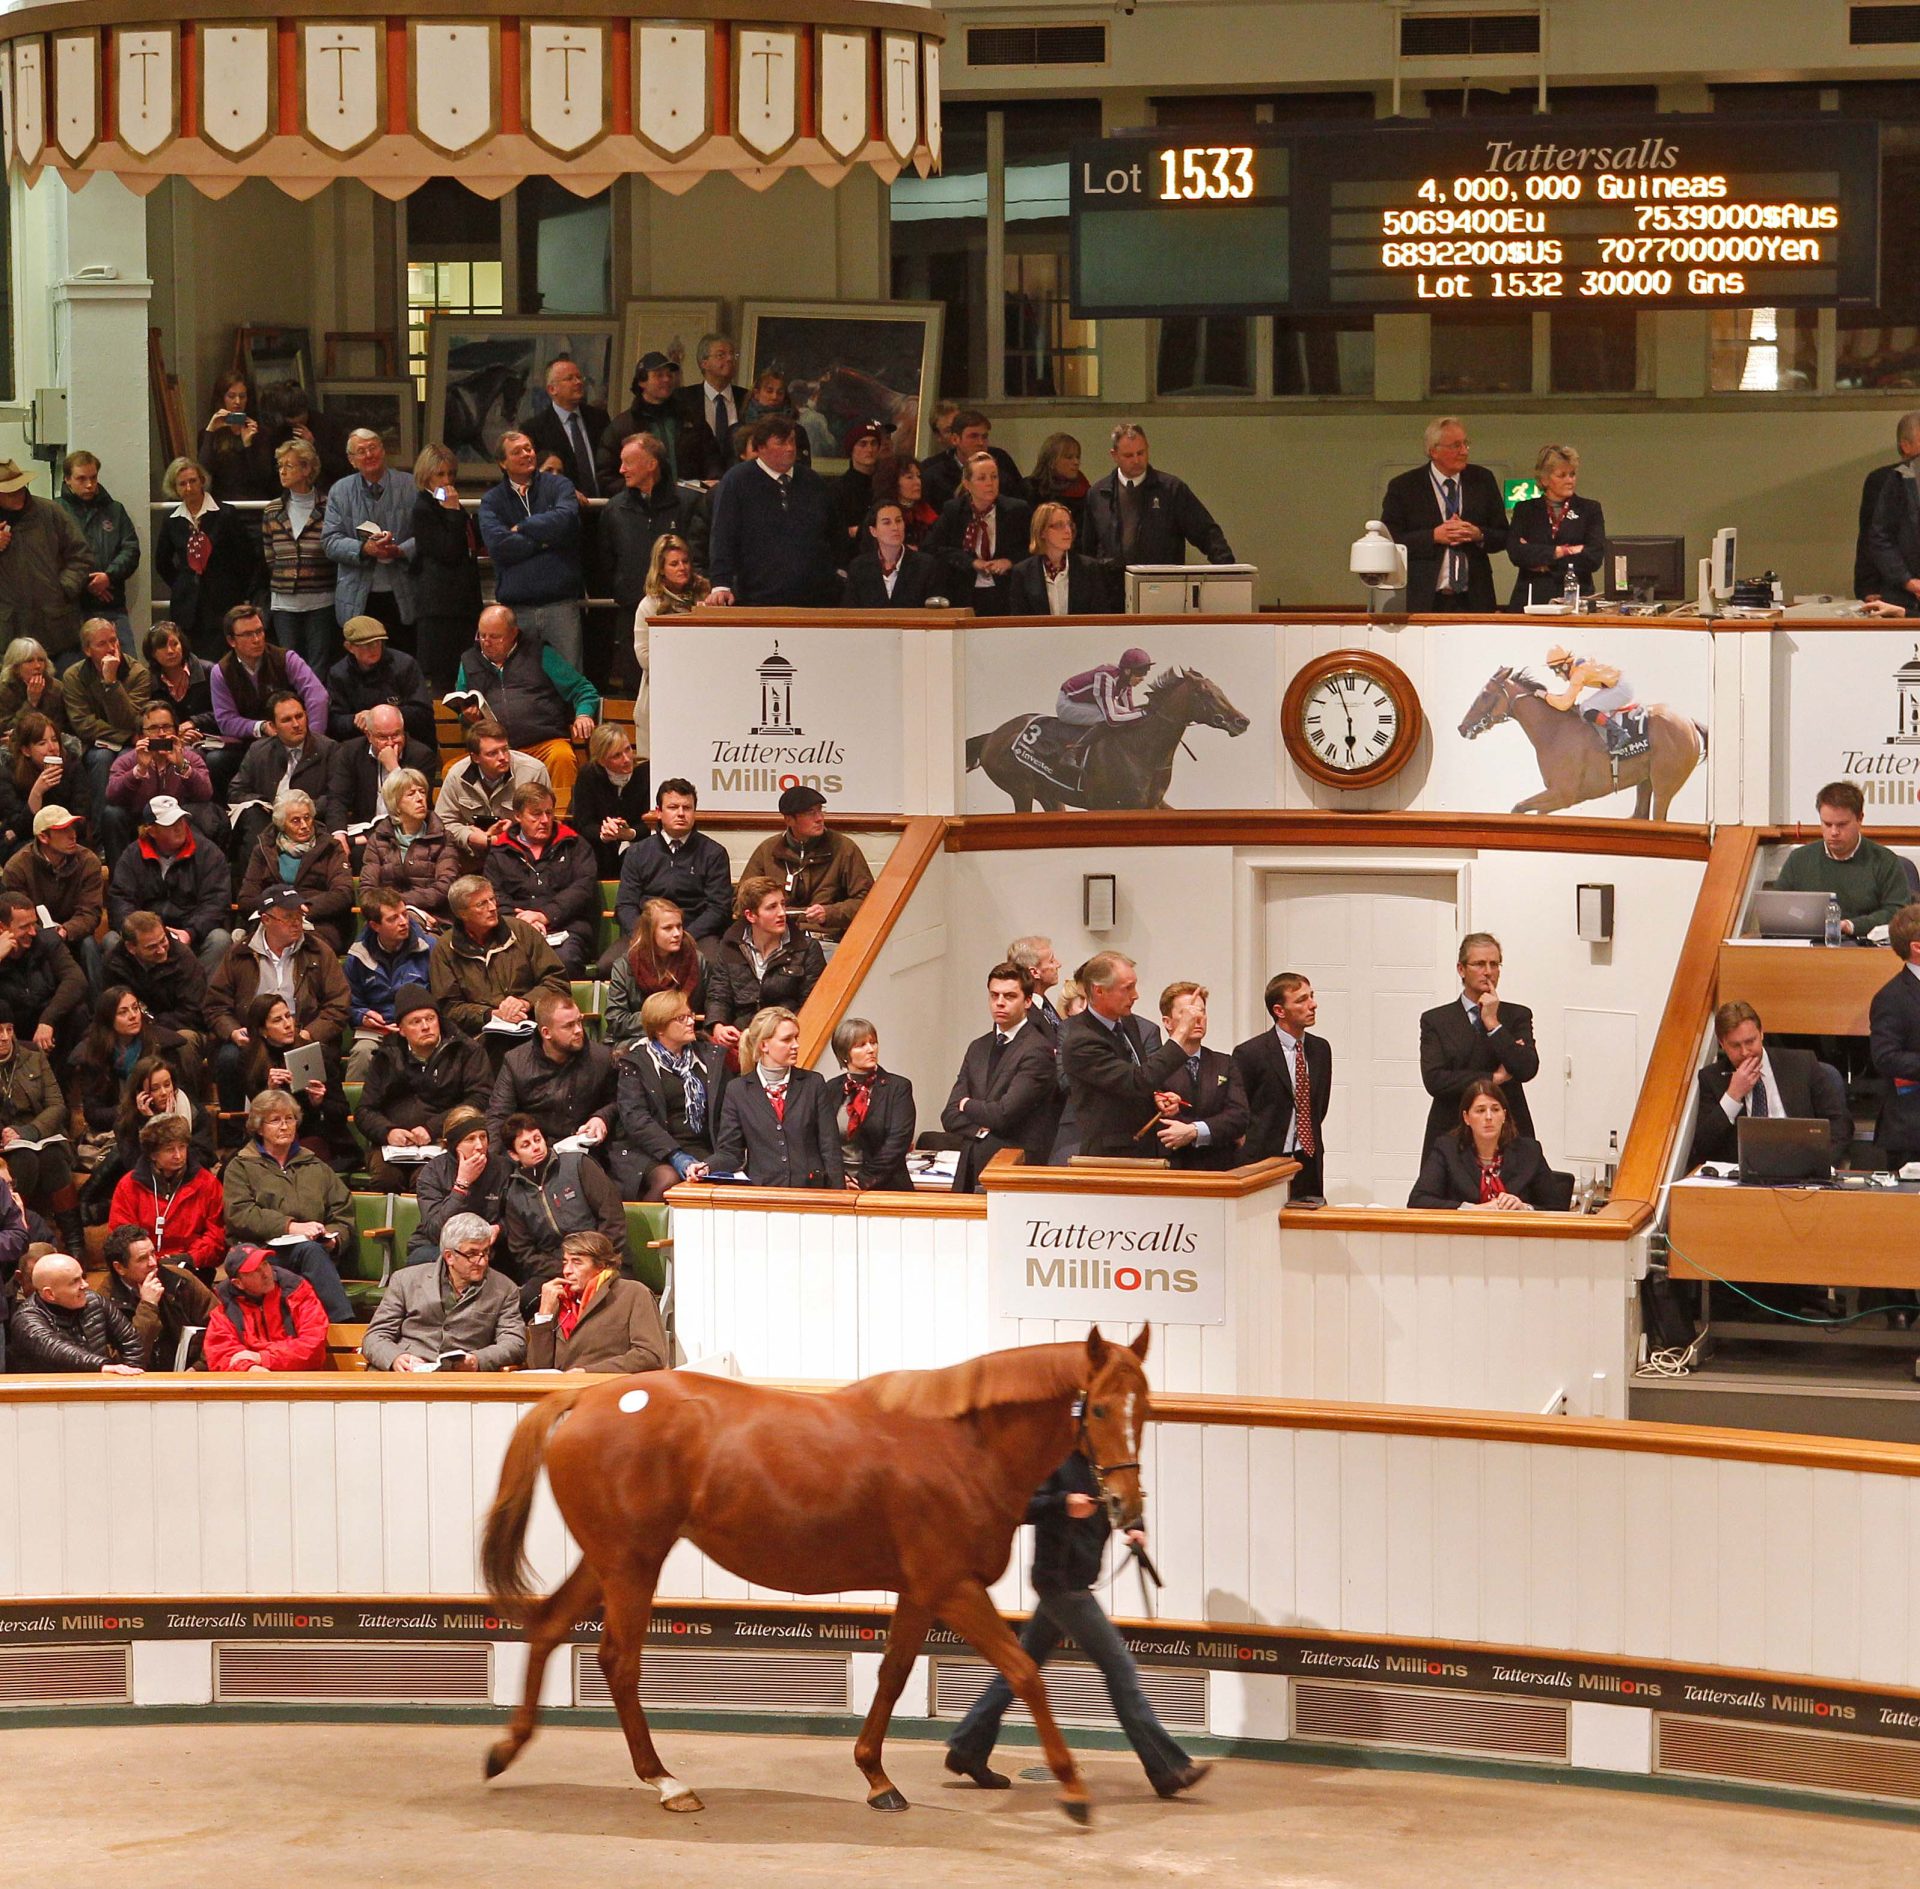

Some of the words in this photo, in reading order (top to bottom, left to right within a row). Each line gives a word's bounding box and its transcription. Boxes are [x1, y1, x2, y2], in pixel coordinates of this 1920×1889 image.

[1484, 137, 1680, 173] Tattersalls
[1084, 163, 1142, 194] Lot
[1160, 147, 1254, 200] 1533
[1418, 174, 1581, 204] 4,000,000
[1597, 174, 1728, 200] Guineas
[1382, 208, 1545, 236] 5069400Eu
[1634, 203, 1838, 231] 7539000$Aus
[1382, 240, 1563, 267] 6892200$US
[1597, 236, 1819, 264] 707700000Yen
[1417, 273, 1472, 298] Lot
[1490, 272, 1563, 297] 1532
[1579, 270, 1672, 296] 30000
[1688, 269, 1745, 295] Gns
[1022, 724, 1042, 745] 3
[711, 740, 846, 764] Tattersalls
[711, 768, 843, 793] Millions
[1025, 1220, 1198, 1254] Tattersalls
[1025, 1258, 1198, 1293] Millions
[62, 1615, 145, 1630] Millions
[166, 1613, 247, 1629] Tattersalls
[253, 1612, 335, 1628] Millions
[357, 1613, 438, 1629] Tattersalls
[646, 1618, 713, 1635] illions
[734, 1621, 813, 1638] Tattersalls
[819, 1623, 891, 1640] Million
[1119, 1639, 1192, 1656] attersalls
[1196, 1641, 1278, 1663] Millions
[1300, 1650, 1380, 1671] Tattersalls
[1386, 1655, 1468, 1677] Millions
[1491, 1665, 1573, 1688] Tattersalls
[1578, 1673, 1662, 1697] Millions
[1683, 1685, 1766, 1709] Tattersalls
[1772, 1694, 1856, 1719] Millions
[1880, 1708, 1920, 1727] Tatte
